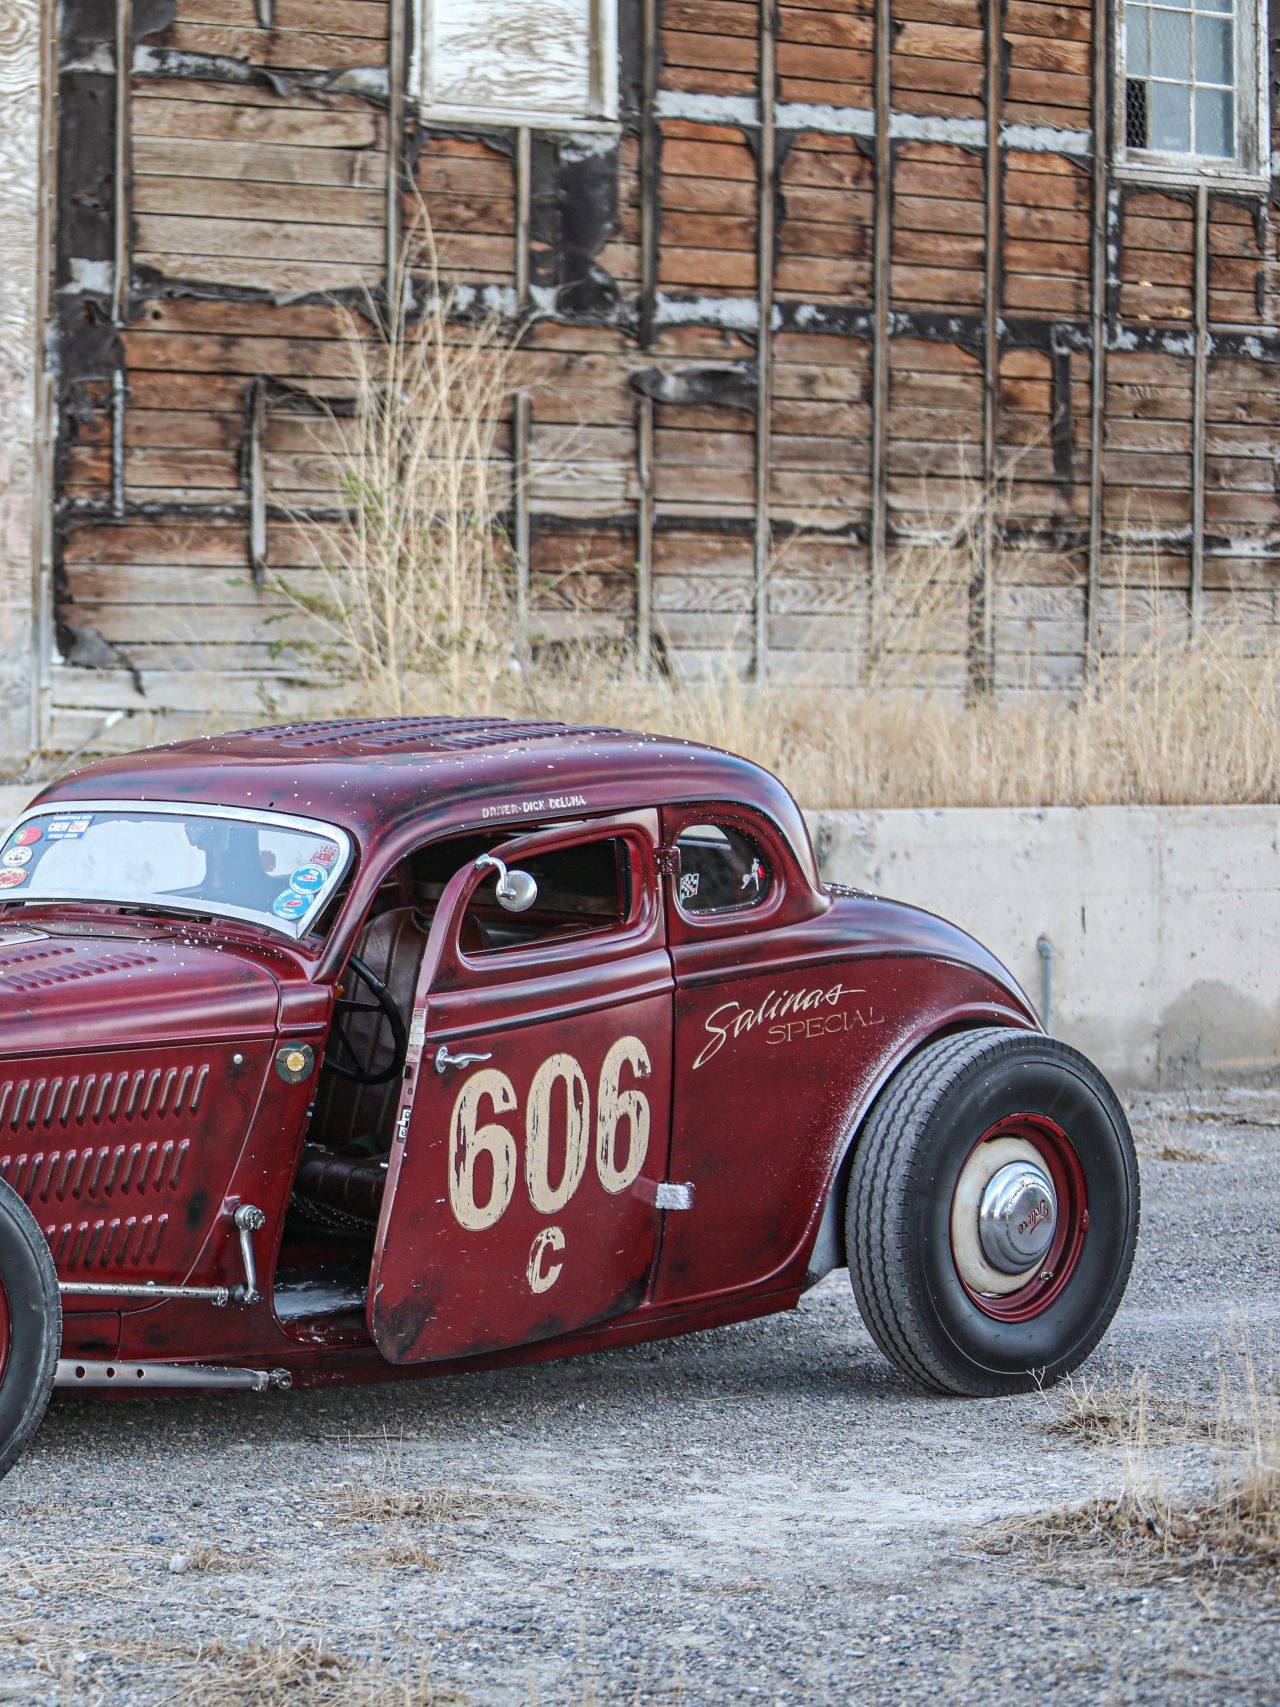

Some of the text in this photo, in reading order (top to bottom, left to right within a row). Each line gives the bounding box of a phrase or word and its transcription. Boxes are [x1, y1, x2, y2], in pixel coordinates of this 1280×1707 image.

[523, 799, 545, 813] DICK
[693, 984, 866, 1070] Salinas
[766, 1007, 885, 1045] SPECIAL
[448, 1035, 652, 1231] 606
